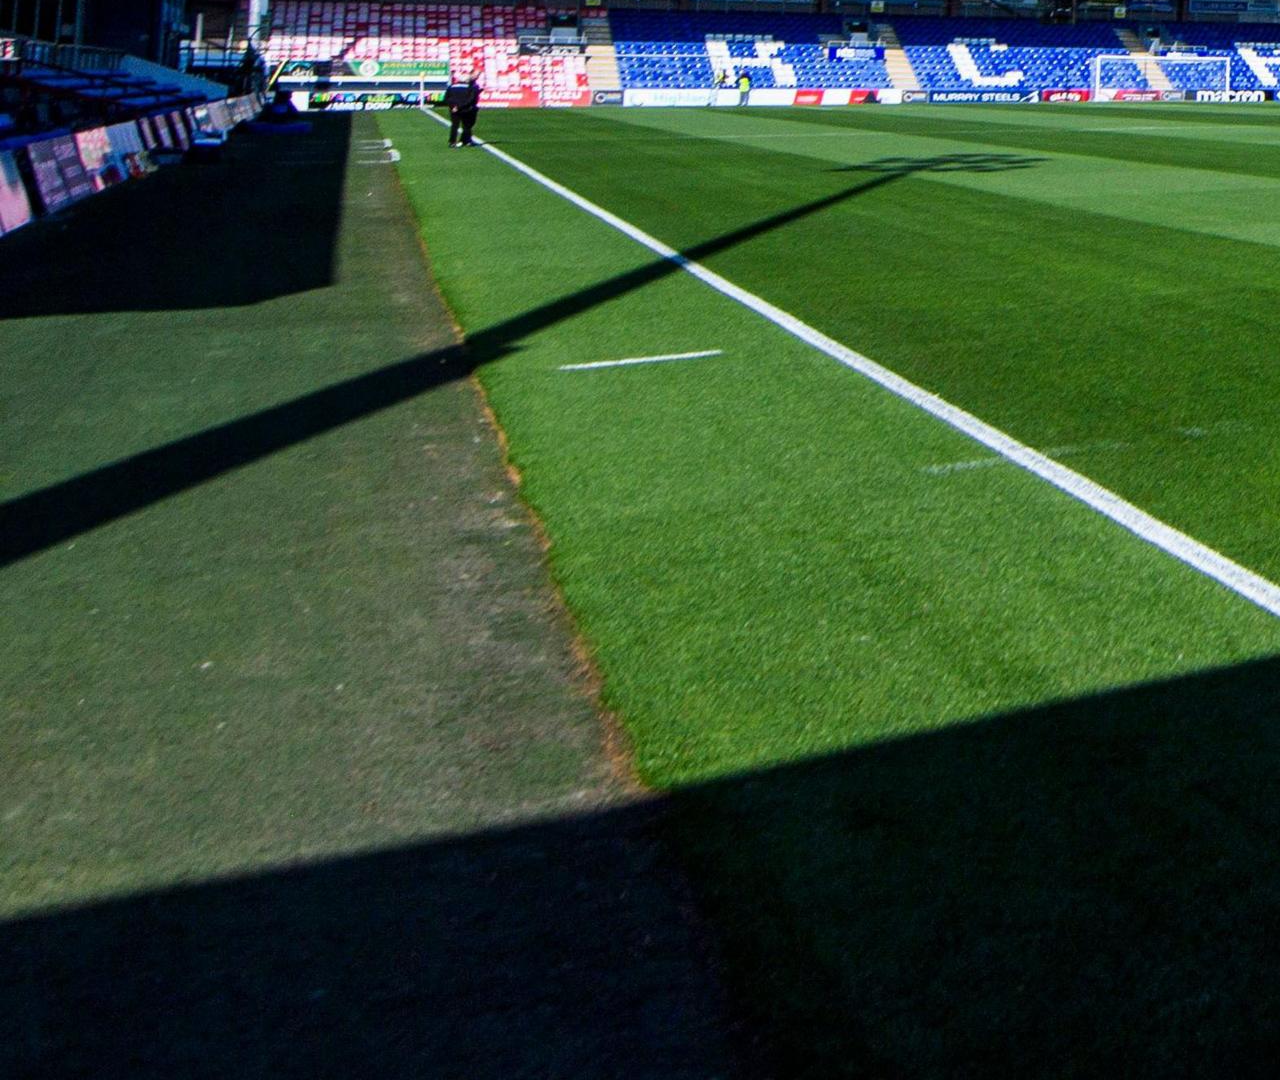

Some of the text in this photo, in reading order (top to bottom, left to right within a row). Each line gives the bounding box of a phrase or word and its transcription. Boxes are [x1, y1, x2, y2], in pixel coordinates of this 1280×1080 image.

[932, 92, 1020, 102] MURRAY STEELS
[1196, 90, 1265, 103] macron
